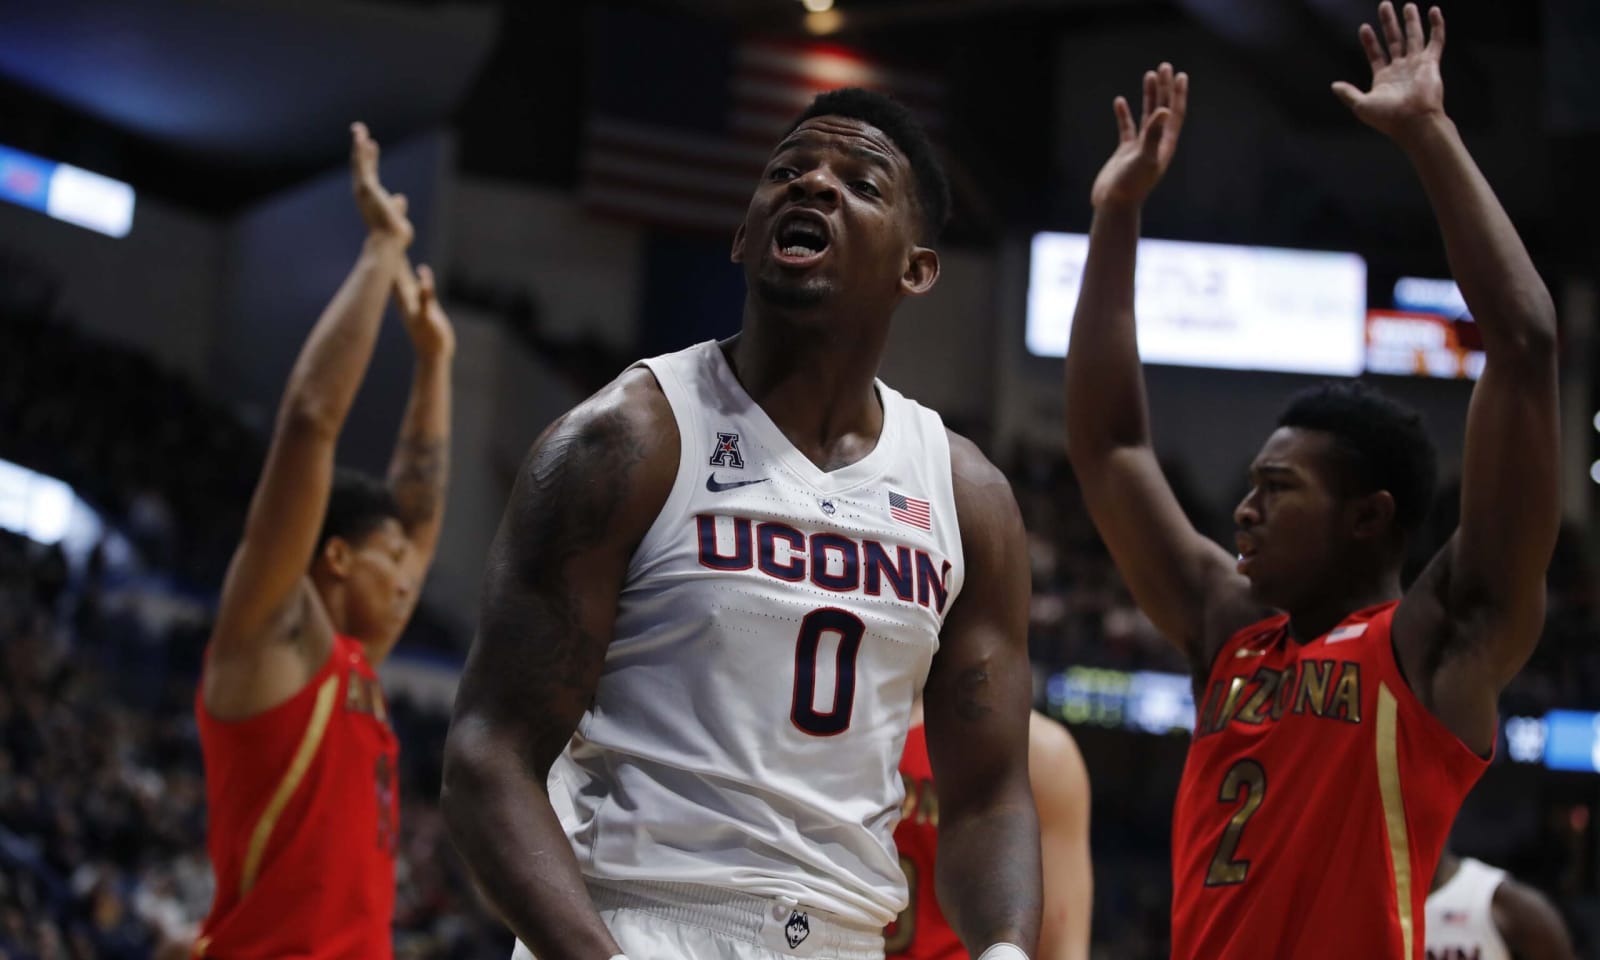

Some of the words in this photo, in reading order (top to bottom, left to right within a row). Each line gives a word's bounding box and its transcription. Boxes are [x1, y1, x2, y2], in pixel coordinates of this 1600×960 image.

[710, 432, 744, 469] A
[696, 514, 952, 616] UCONN
[790, 606, 866, 737] 0
[1198, 659, 1361, 737] AIZONA
[1203, 757, 1267, 888] 2
